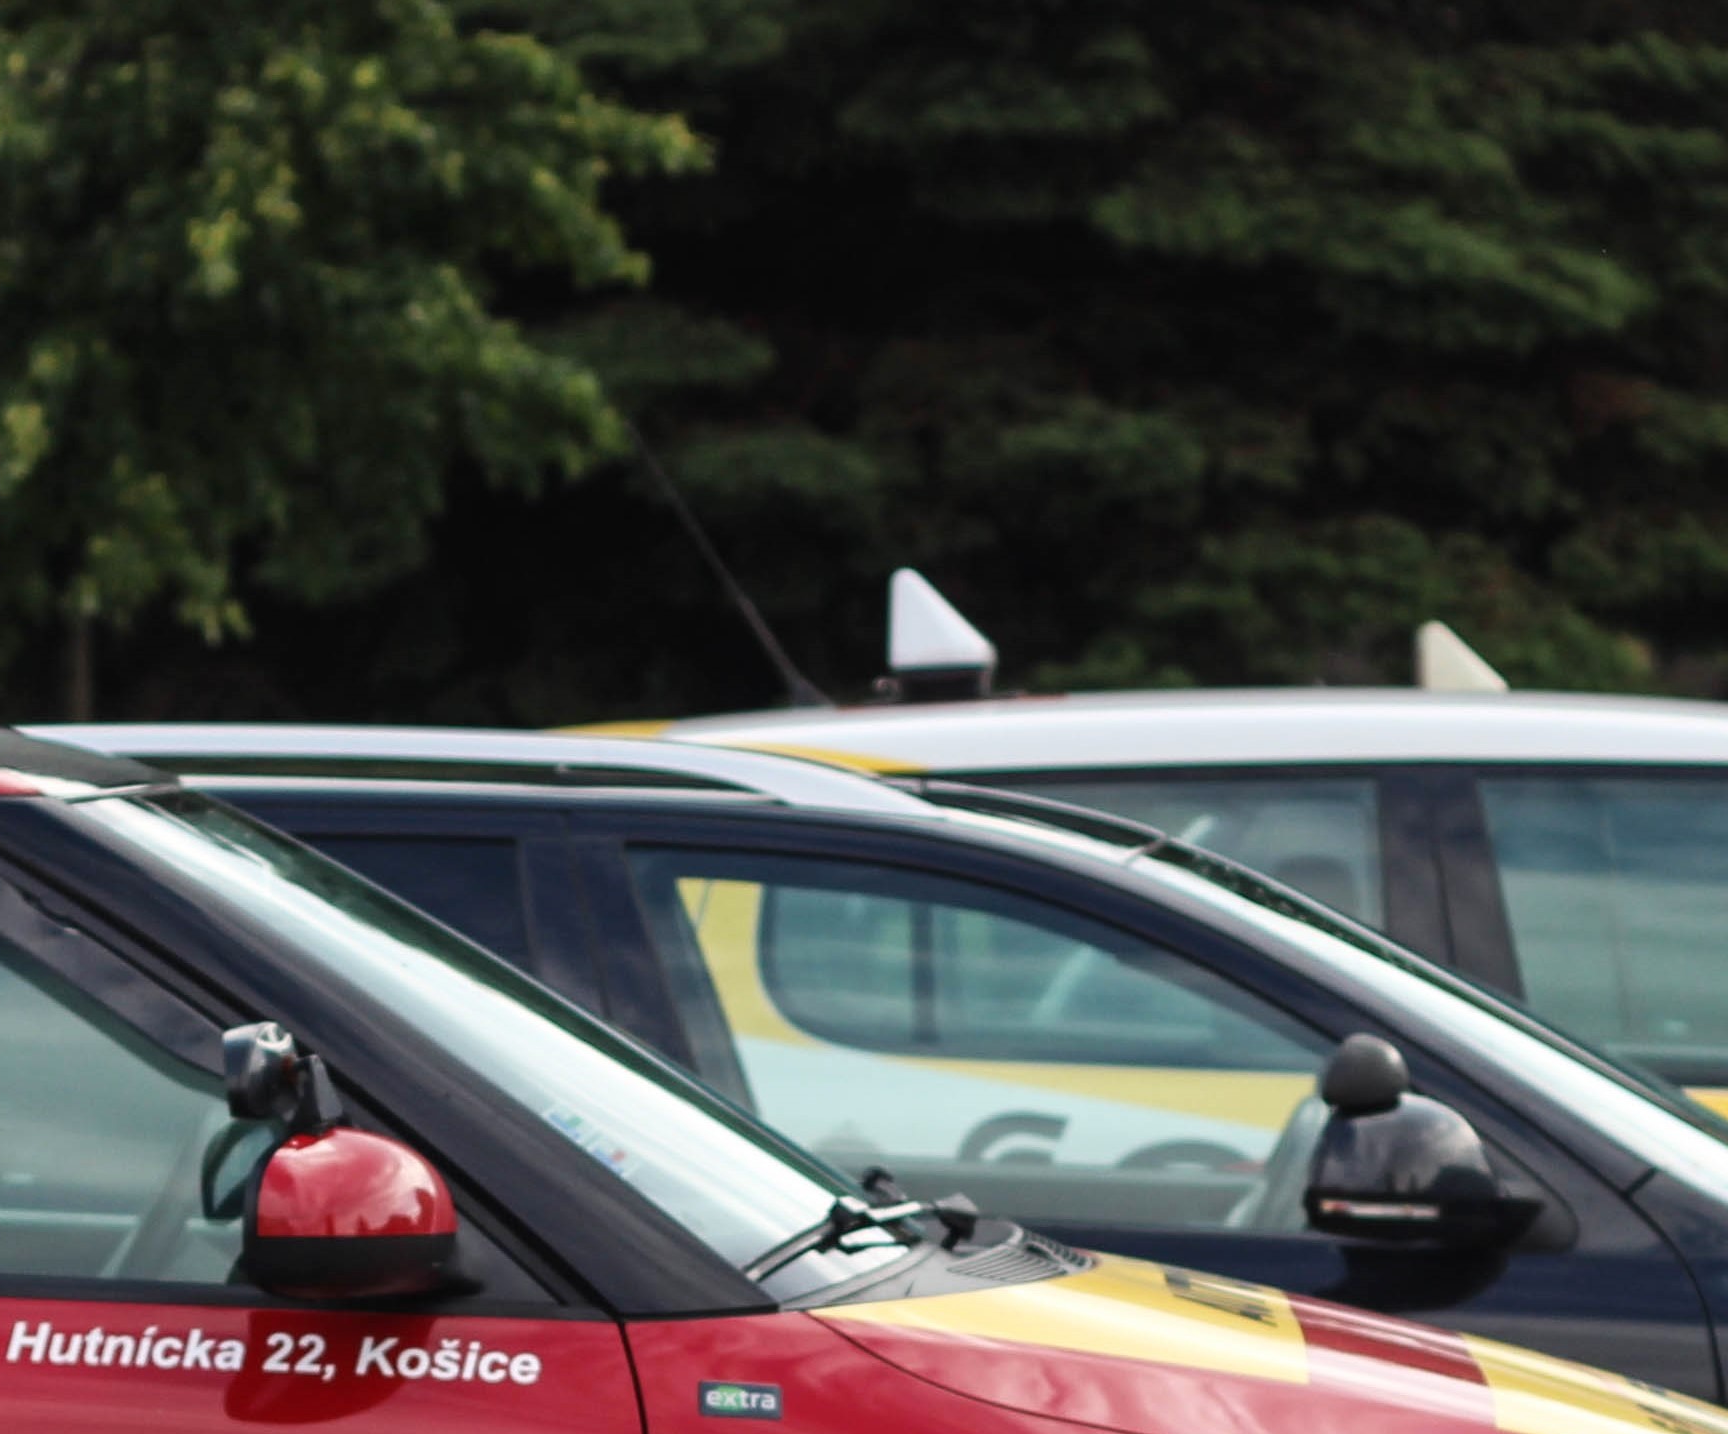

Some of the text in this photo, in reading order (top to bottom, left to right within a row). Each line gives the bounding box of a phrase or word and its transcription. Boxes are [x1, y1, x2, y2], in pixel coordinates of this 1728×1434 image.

[5, 1319, 246, 1372] Hutnícka
[261, 1331, 336, 1381] 22,
[355, 1337, 542, 1386] Košice
[705, 1390, 776, 1411] extra
